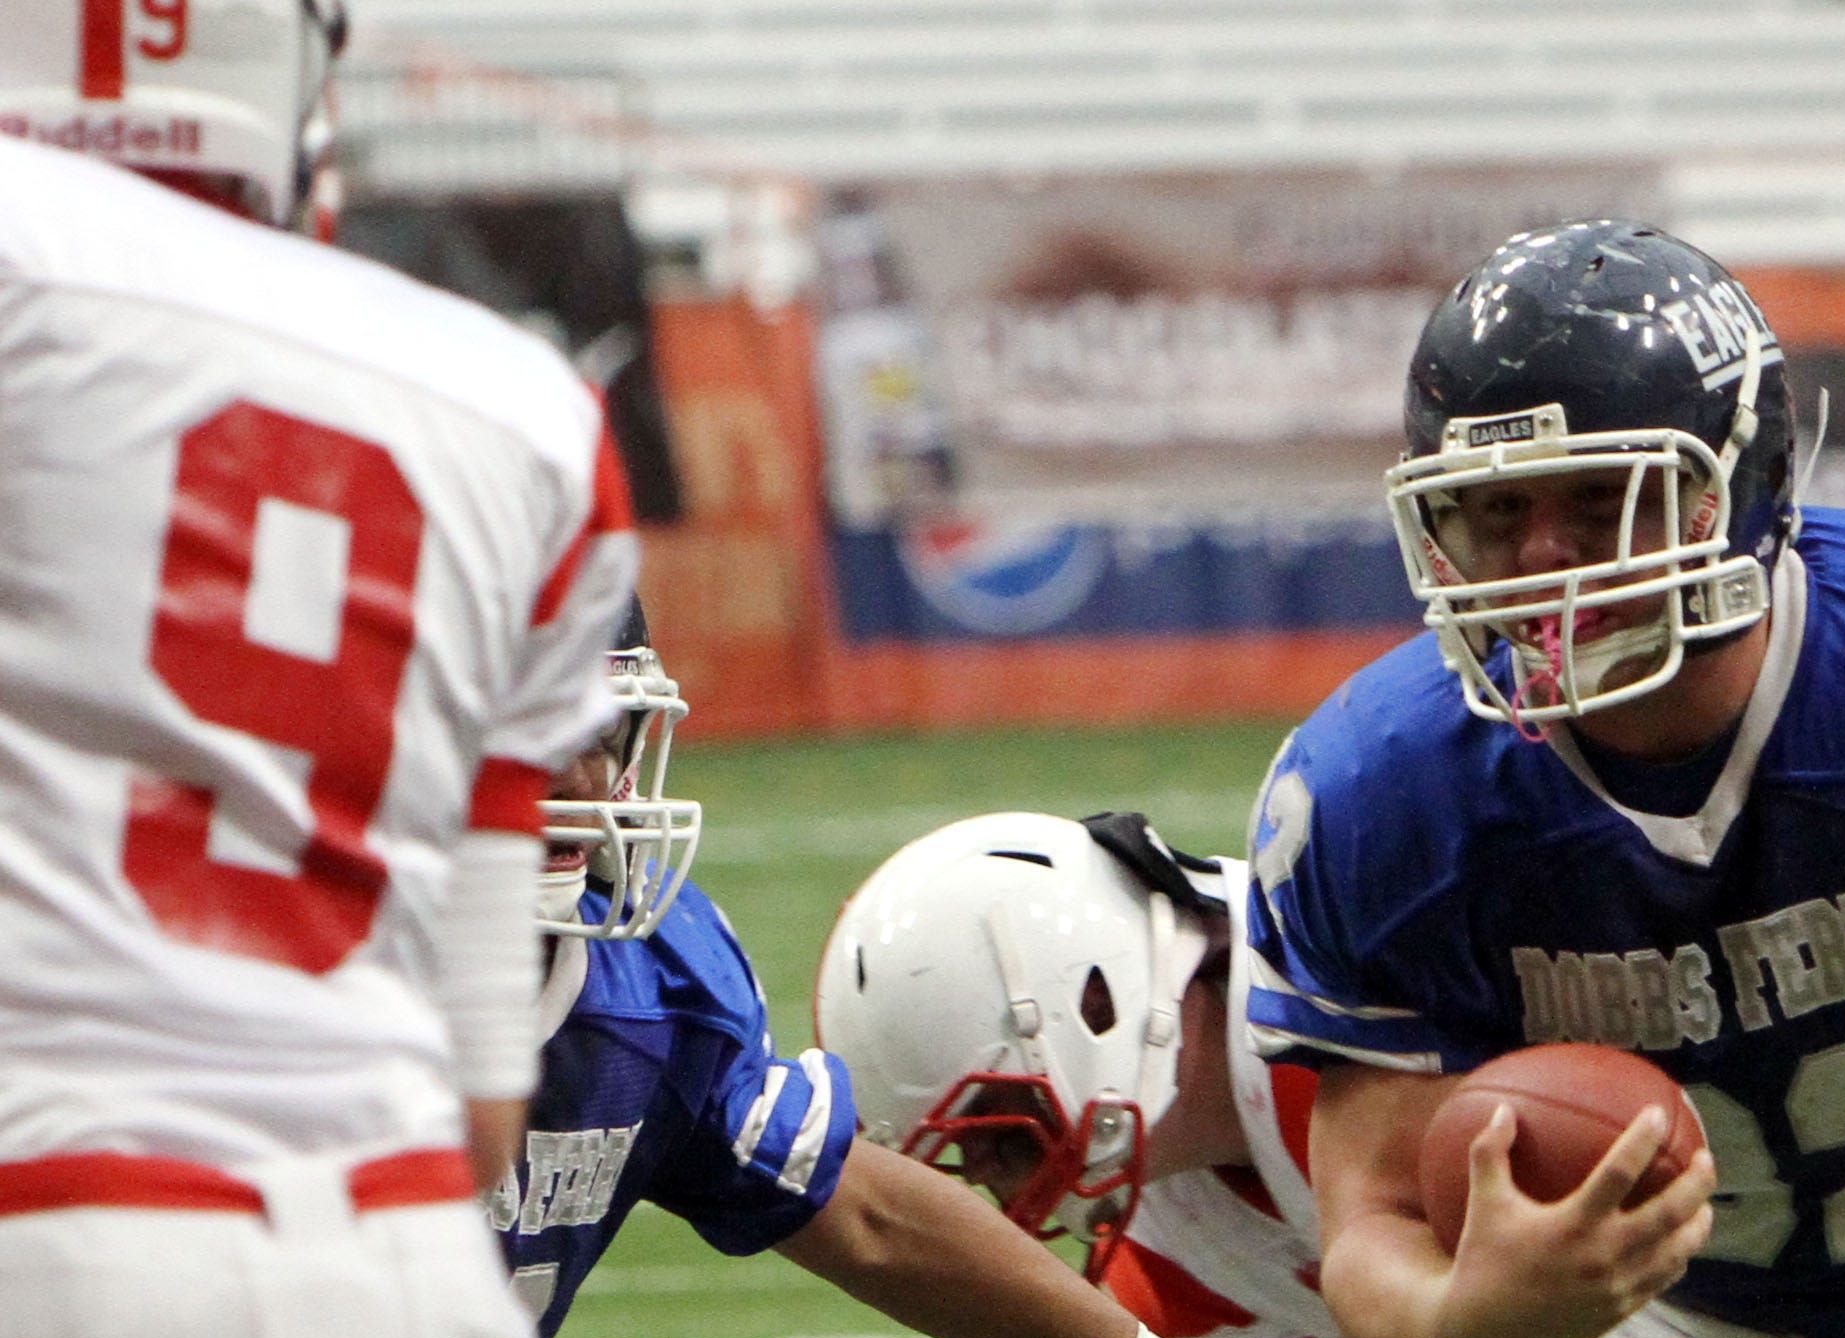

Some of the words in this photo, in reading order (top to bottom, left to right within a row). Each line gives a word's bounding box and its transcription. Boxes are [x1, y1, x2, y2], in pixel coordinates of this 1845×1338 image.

[1470, 420, 1532, 446] EAGLES
[120, 399, 426, 979] 9
[1510, 945, 1723, 1051] DOBBS
